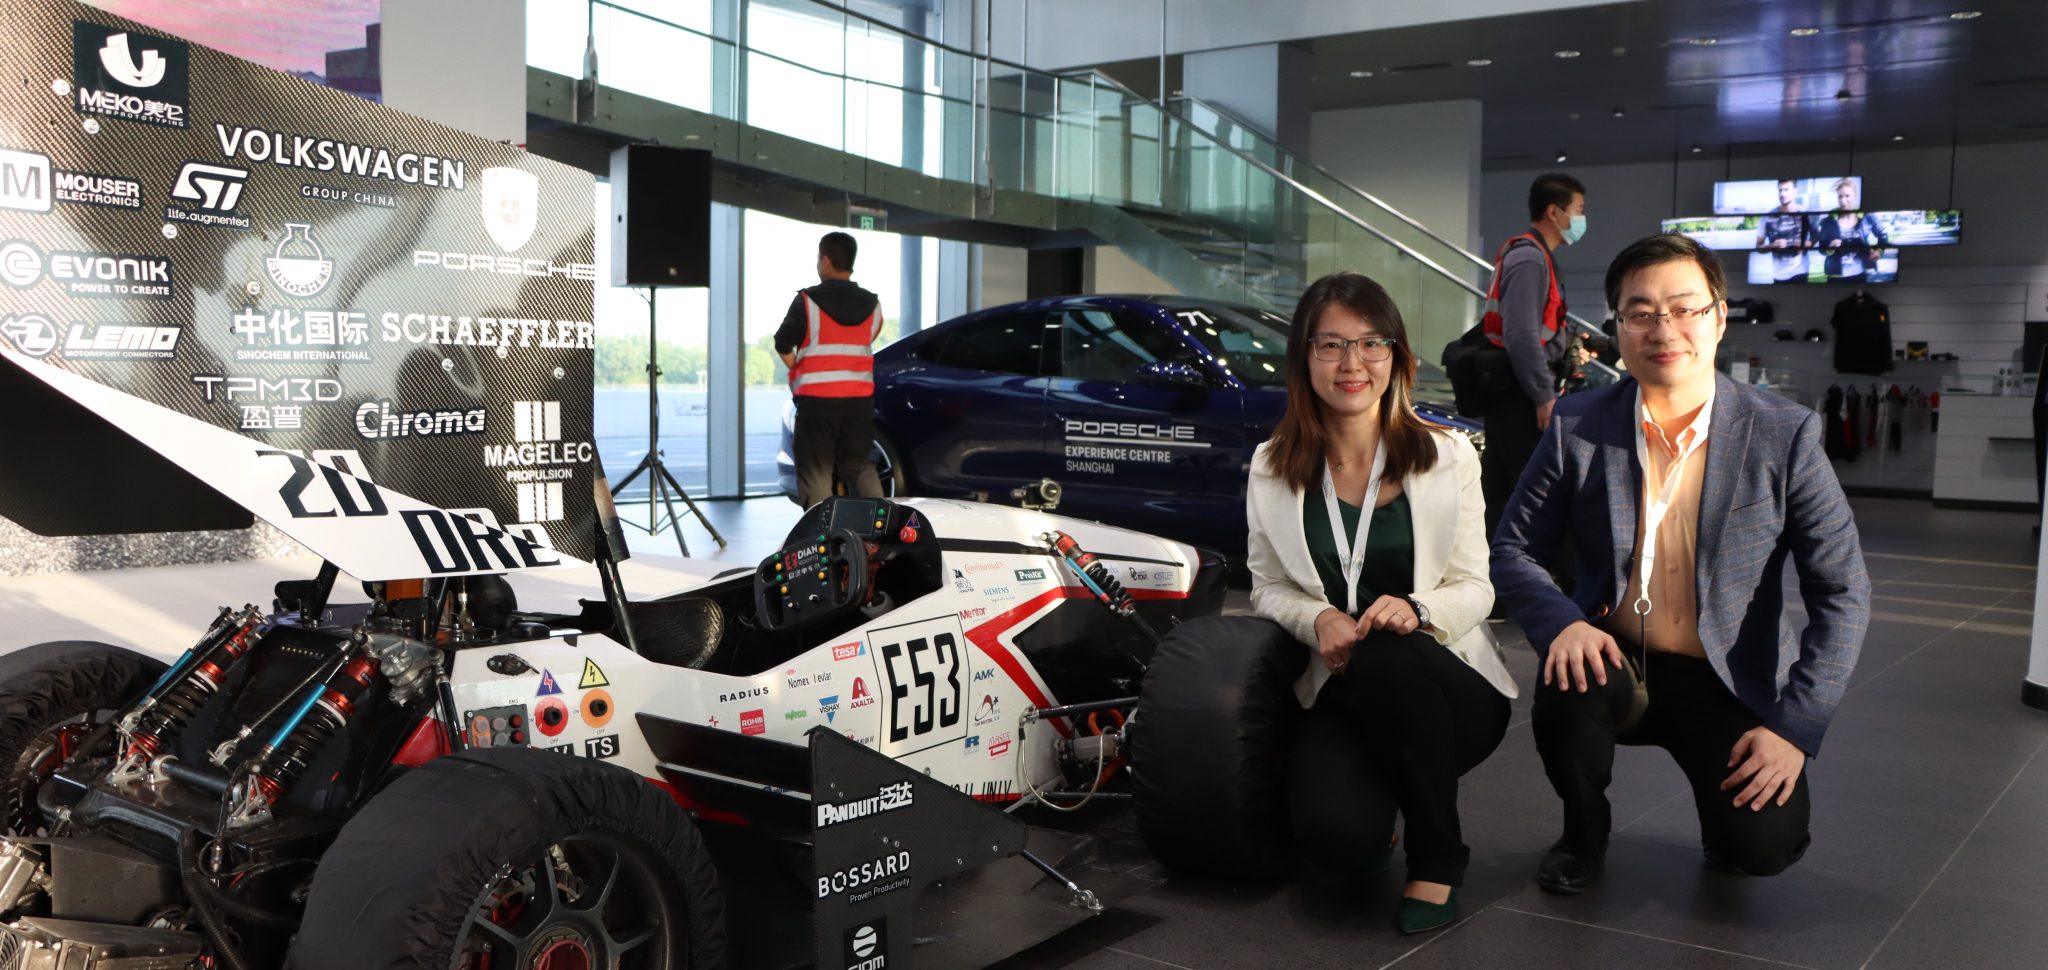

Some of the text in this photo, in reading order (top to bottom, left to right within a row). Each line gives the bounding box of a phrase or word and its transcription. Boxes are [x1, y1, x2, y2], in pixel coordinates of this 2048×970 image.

[80, 87, 143, 114] MEKO
[113, 111, 184, 127] PROTOTYPING
[216, 124, 465, 190] VOLKSWAGEN
[55, 172, 140, 198] MOUSER
[302, 185, 396, 207] GROUP CHINA
[56, 190, 140, 208] ELECTRONICS
[167, 208, 250, 228] life.augmented
[51, 254, 170, 282] EVONIK
[413, 251, 595, 280] PORSCHE
[268, 260, 331, 294] SINOCHEM
[71, 282, 170, 296] POWER TO CREATE
[65, 325, 181, 350] LEMO
[234, 307, 369, 346] 中化国际
[381, 311, 595, 350] SCHAEFFLER
[236, 350, 371, 361] SINOCHEM INTERNATIONAL
[193, 376, 343, 402] TPM3D
[240, 404, 302, 430] 盈普
[355, 402, 486, 439] Chroma
[1065, 420, 1195, 440] PORSCHE
[484, 442, 593, 467] MAGELEC
[1065, 445, 1171, 463] EXPERIENCE CENTRE
[506, 469, 573, 481] PROPULSION
[1066, 460, 1115, 474] SHANGHAI
[797, 544, 818, 560] DIAN
[959, 607, 987, 620] Mentor
[835, 645, 857, 659] tesa
[787, 677, 810, 689] Nomex
[974, 668, 995, 682] AMK
[719, 686, 770, 703] RADIUS
[881, 632, 961, 744] E53
[819, 703, 841, 714] VISHAY
[851, 697, 875, 710] AXALTA
[742, 716, 764, 727] ROHM
[587, 736, 614, 758] TS
[817, 796, 880, 828] PANDUIT
[818, 850, 910, 899] BOSSARD
[850, 877, 910, 904] Proven Productivity
